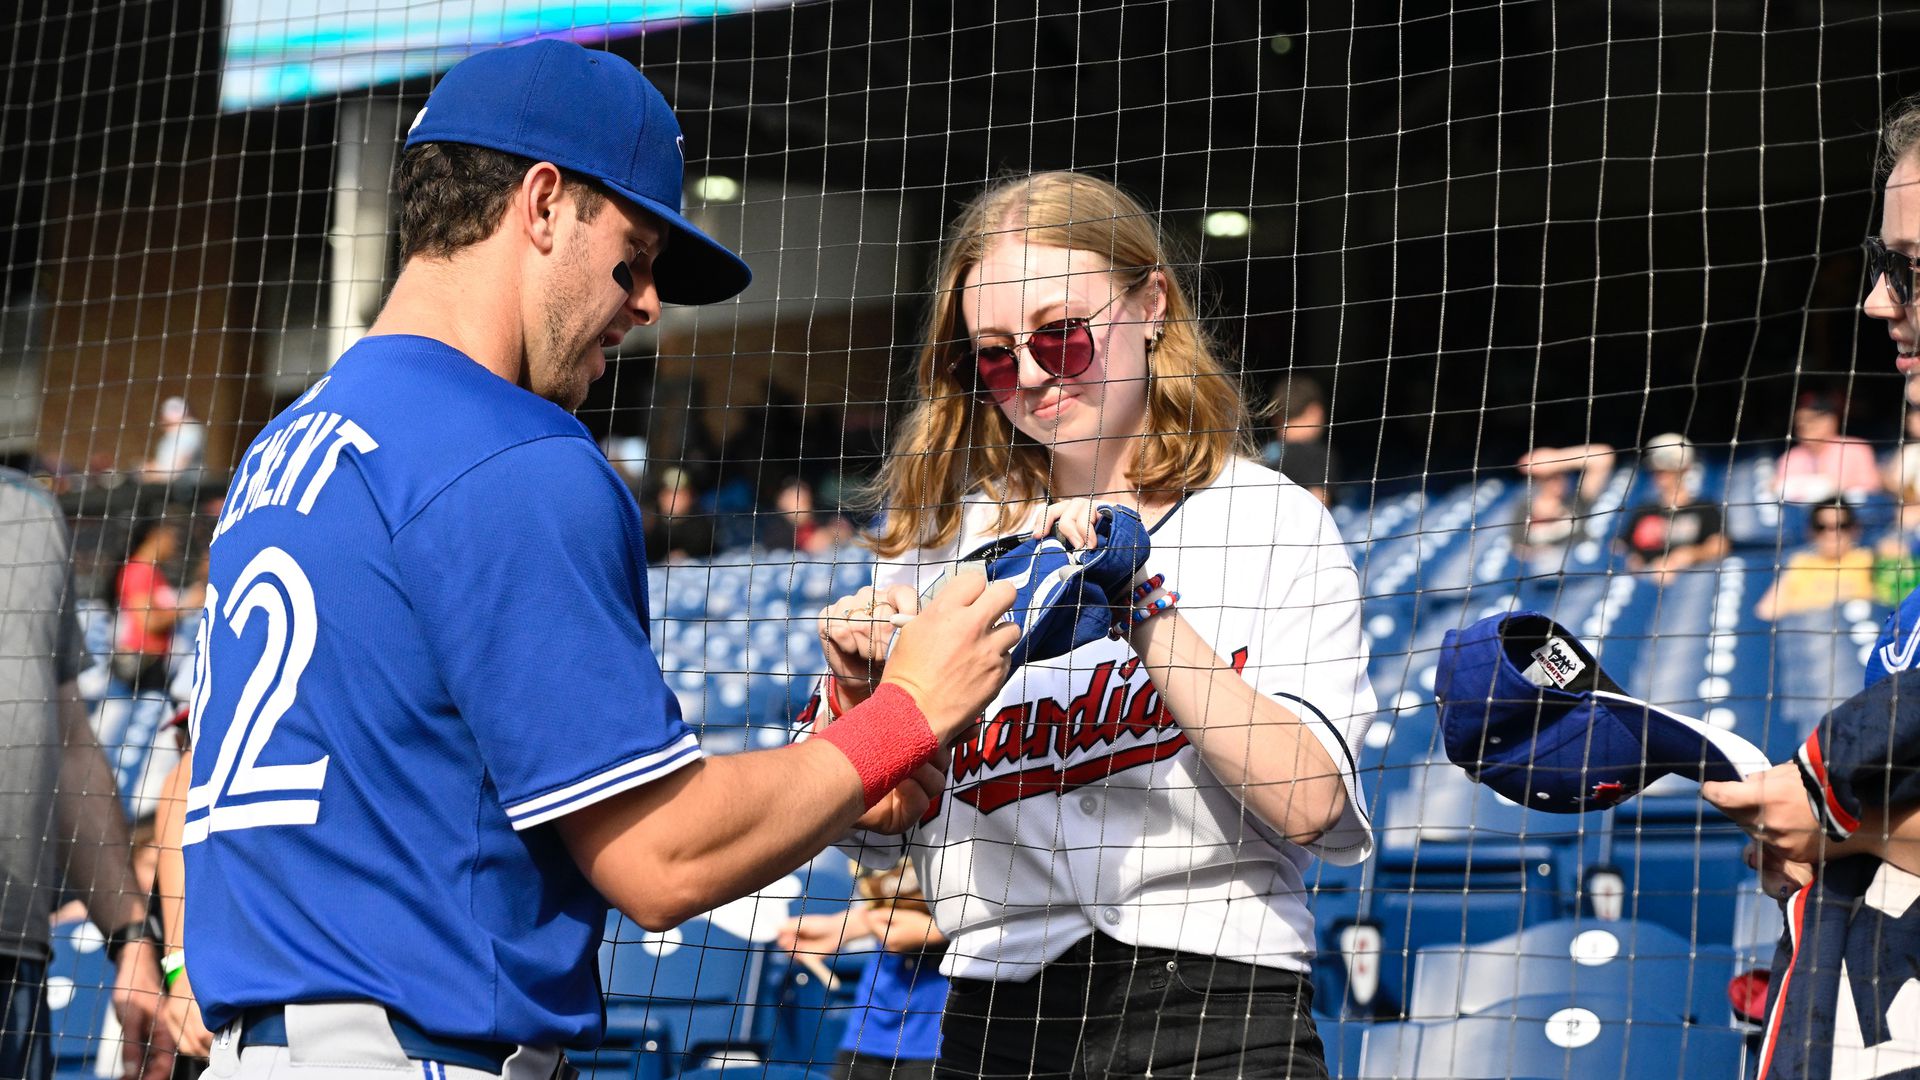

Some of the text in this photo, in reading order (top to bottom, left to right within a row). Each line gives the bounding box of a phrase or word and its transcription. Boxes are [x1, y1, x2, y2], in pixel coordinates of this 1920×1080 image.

[1536, 652, 1566, 684] FAVORITE
[1548, 652, 1571, 676] FAN
[1566, 1018, 1581, 1037] 2
